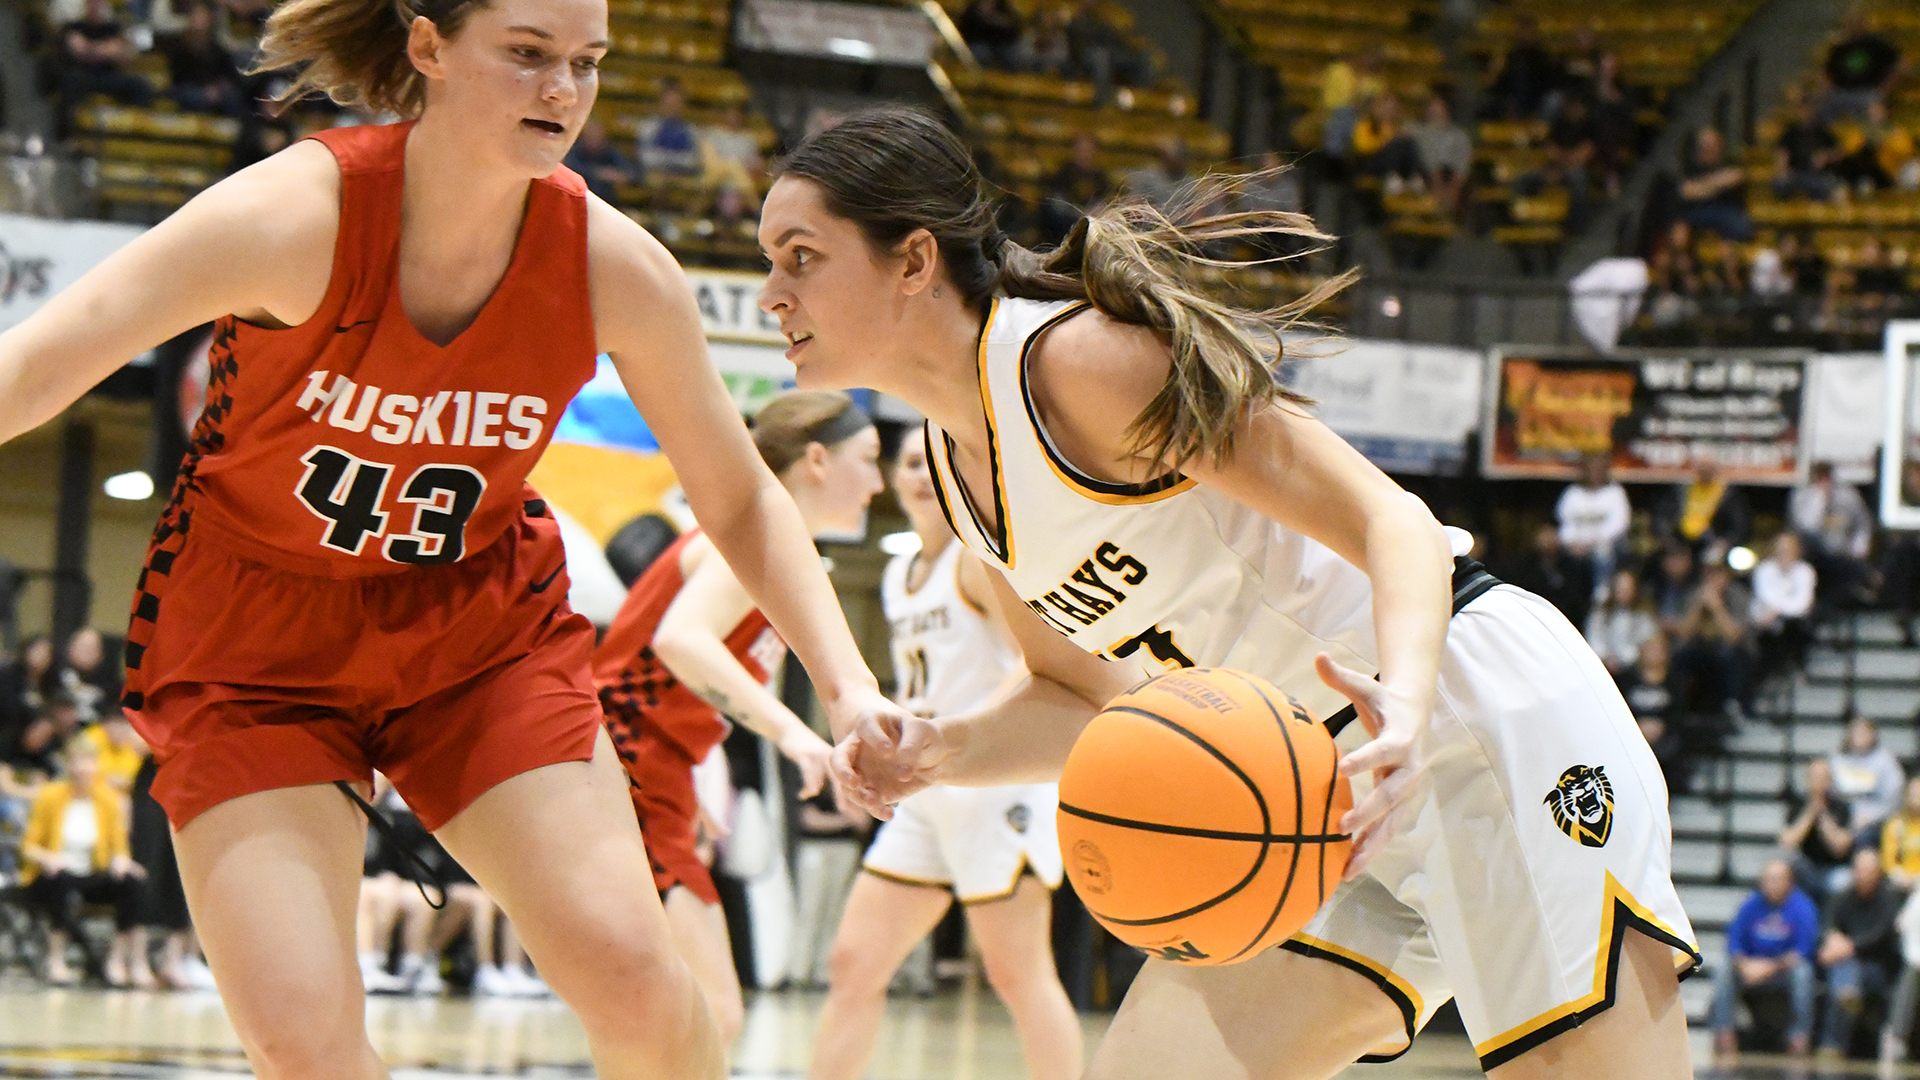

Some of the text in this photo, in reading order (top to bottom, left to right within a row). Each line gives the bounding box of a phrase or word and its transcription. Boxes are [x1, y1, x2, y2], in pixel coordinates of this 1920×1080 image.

[296, 370, 548, 450] HUSKIES
[294, 444, 488, 564] 43
[1041, 540, 1148, 626] HAYS
